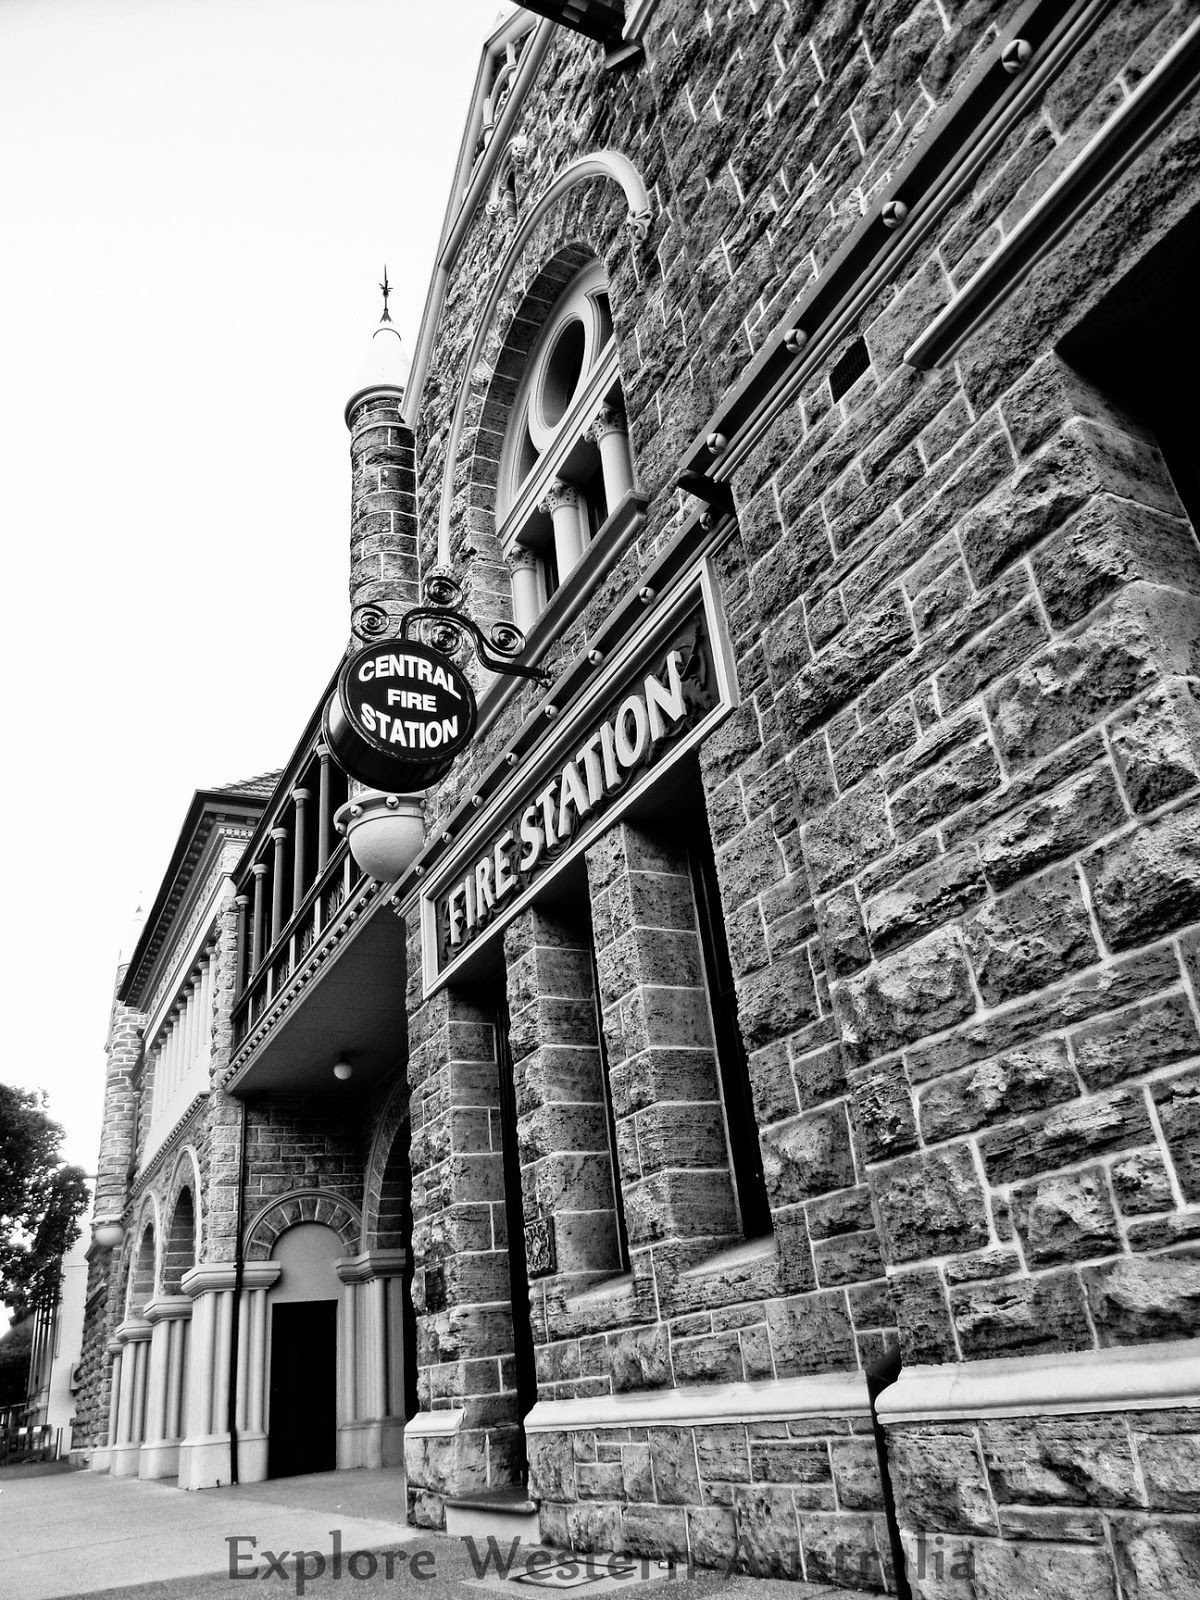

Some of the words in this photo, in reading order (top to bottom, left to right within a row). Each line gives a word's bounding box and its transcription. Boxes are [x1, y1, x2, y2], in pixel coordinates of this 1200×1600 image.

[358, 654, 461, 700] CENTRAL
[387, 688, 437, 713] FIRE
[361, 703, 458, 749] STATION
[449, 830, 518, 945] FIRE
[521, 651, 687, 871] STATION
